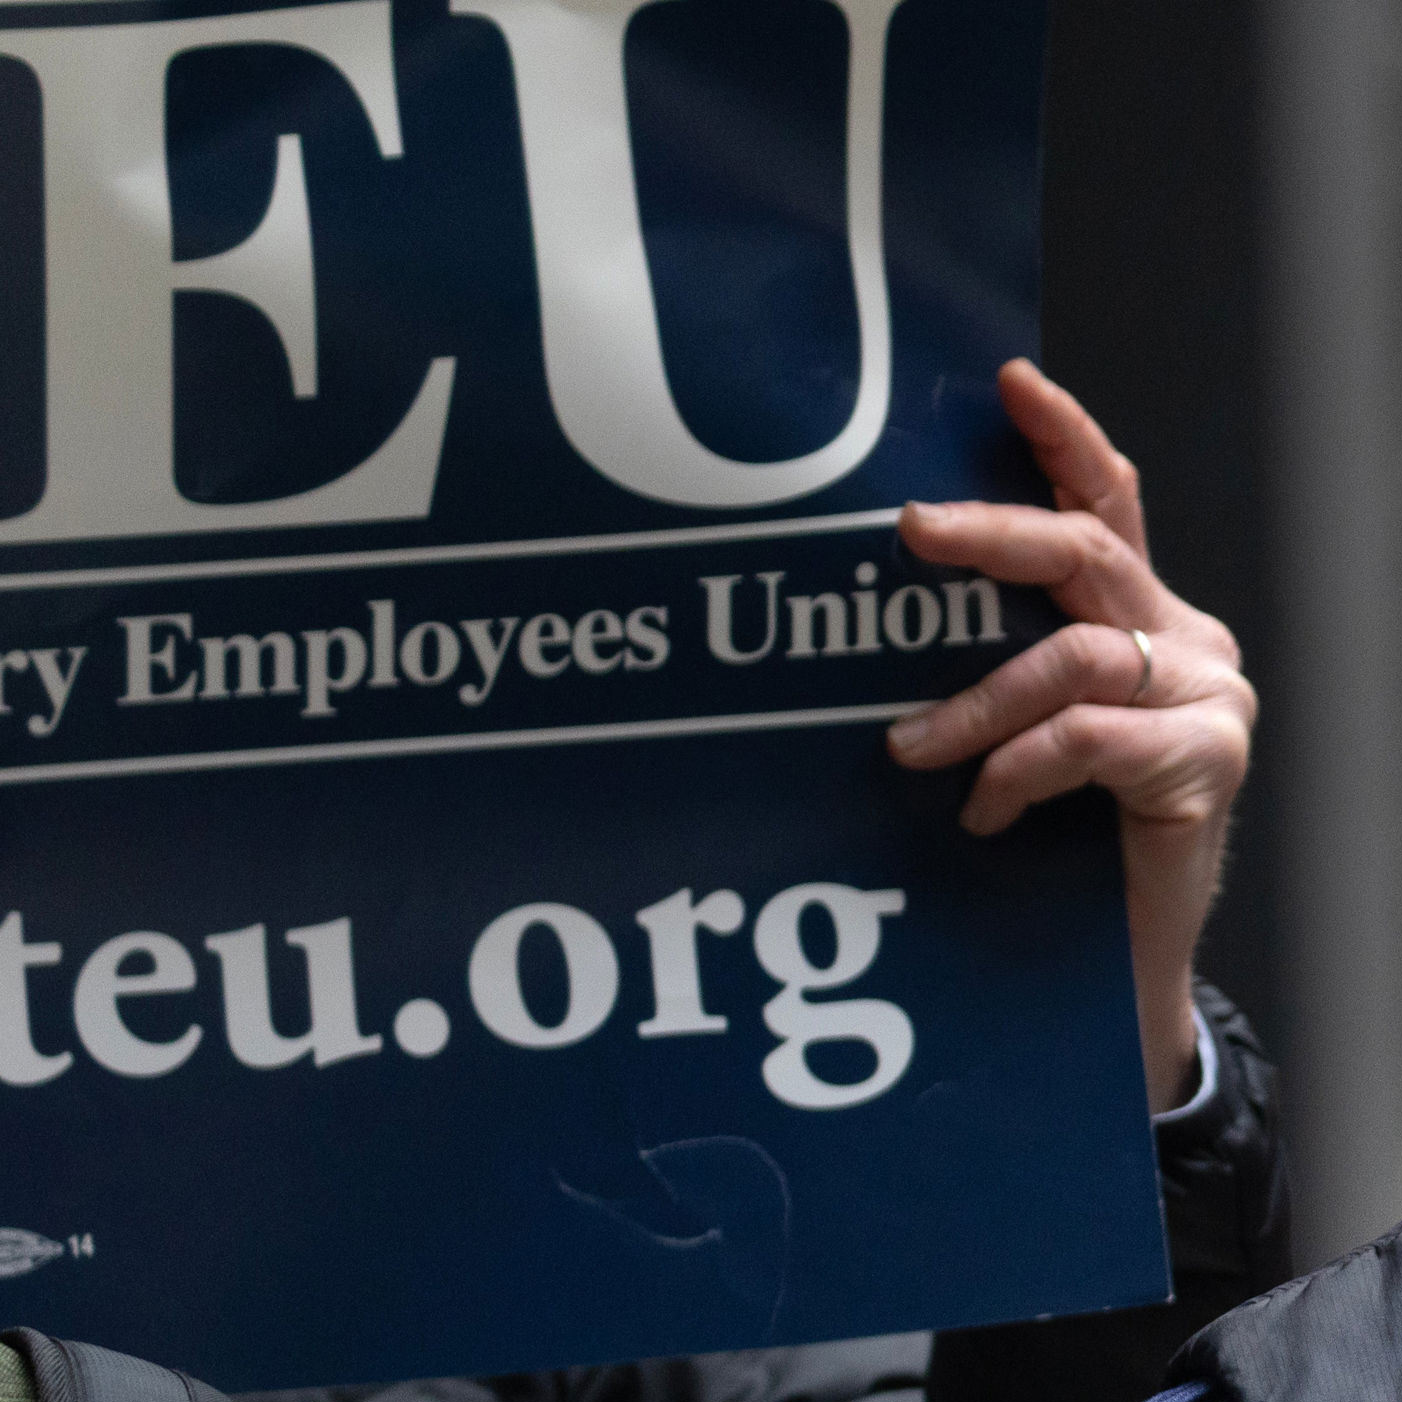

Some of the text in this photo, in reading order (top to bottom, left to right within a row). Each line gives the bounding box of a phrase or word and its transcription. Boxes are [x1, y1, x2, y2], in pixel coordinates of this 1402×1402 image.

[116, 598, 671, 718] Employees
[699, 560, 1007, 666] Union
[0, 881, 915, 1111] teu.org
